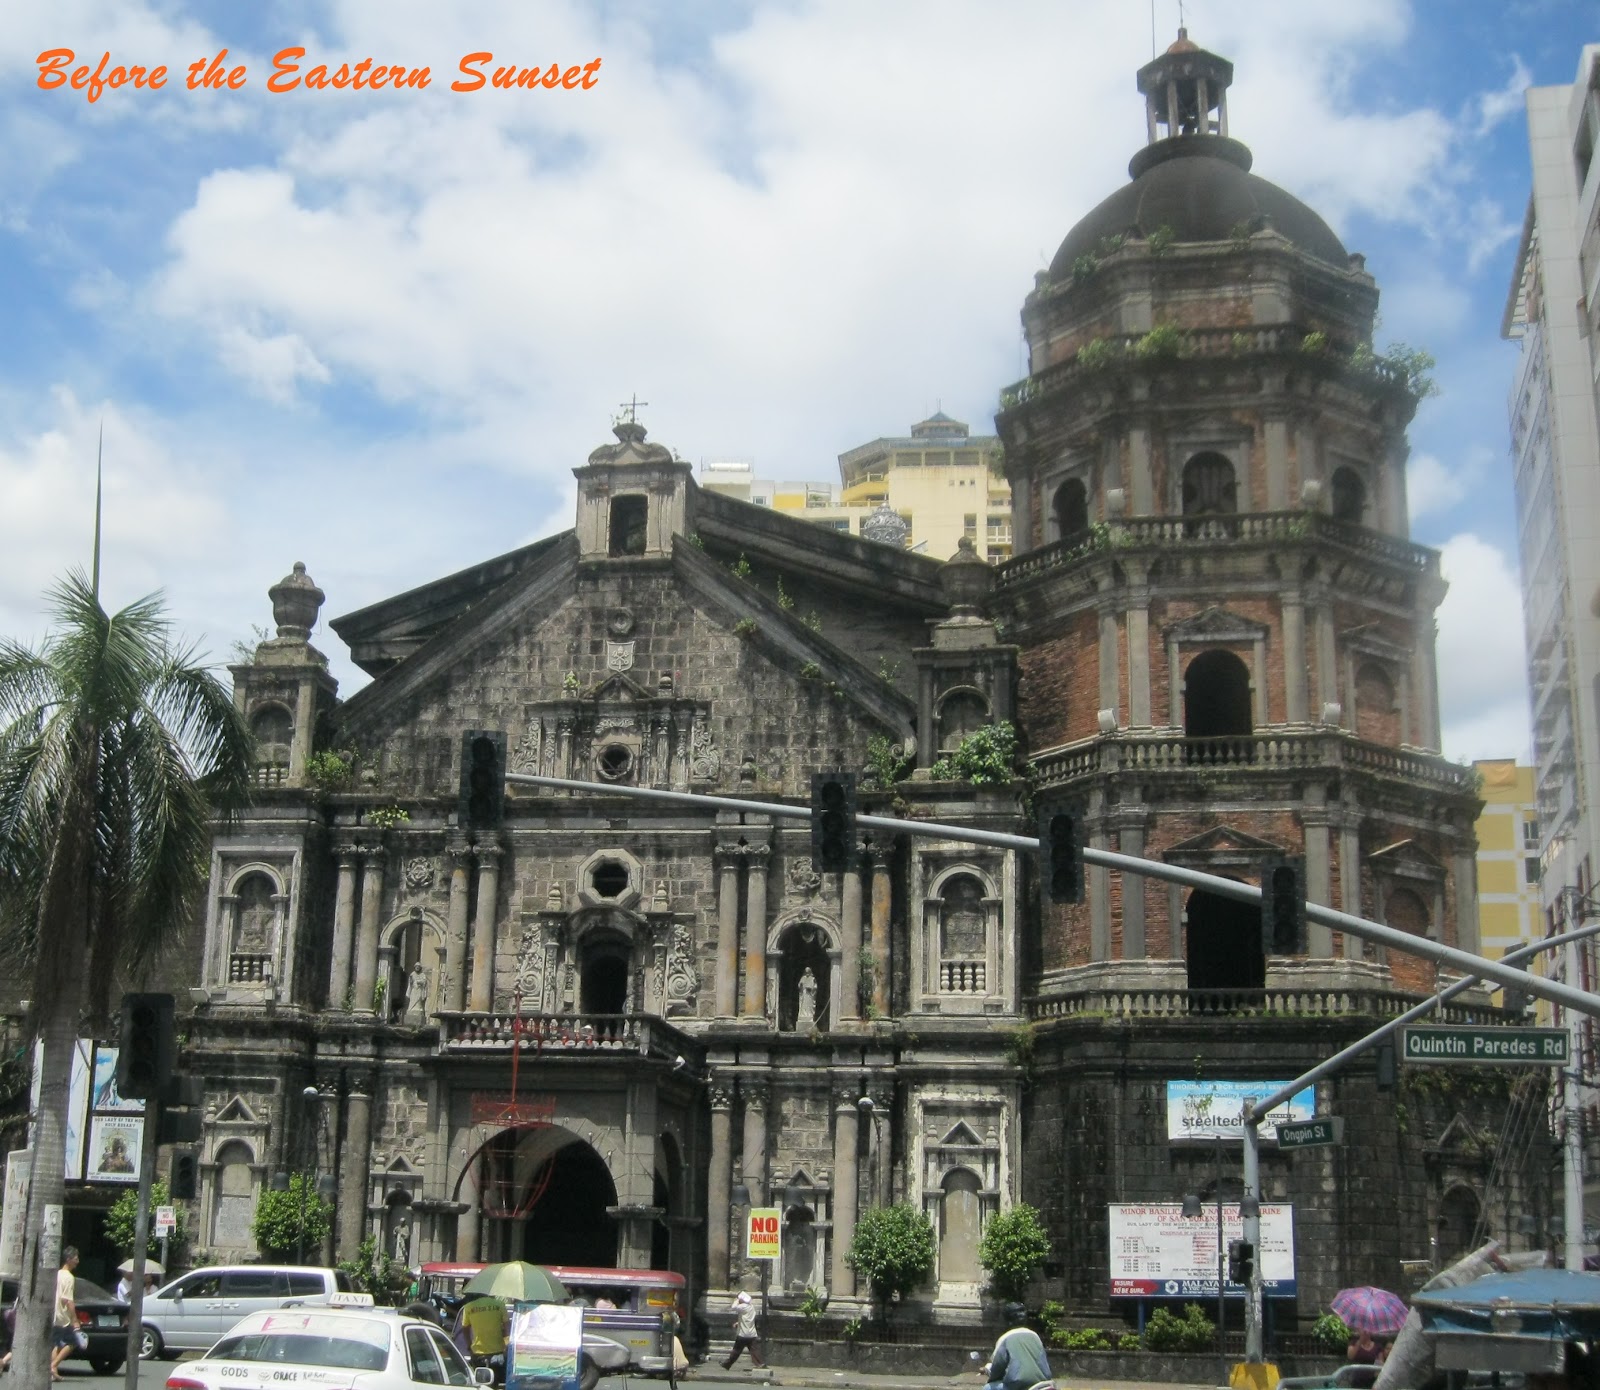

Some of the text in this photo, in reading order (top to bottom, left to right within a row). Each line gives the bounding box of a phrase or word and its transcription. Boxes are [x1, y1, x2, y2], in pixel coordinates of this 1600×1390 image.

[1410, 1035, 1563, 1055] Quintin Paredes Rd
[1182, 1115, 1246, 1127] steeltech
[1283, 1125, 1326, 1143] Ongpin St
[1227, 1215, 1244, 1223] RUI
[751, 1217, 778, 1233] NO
[750, 1234, 779, 1244] PARKING
[334, 1294, 367, 1303] TAXI
[273, 1371, 298, 1381] GRACE
